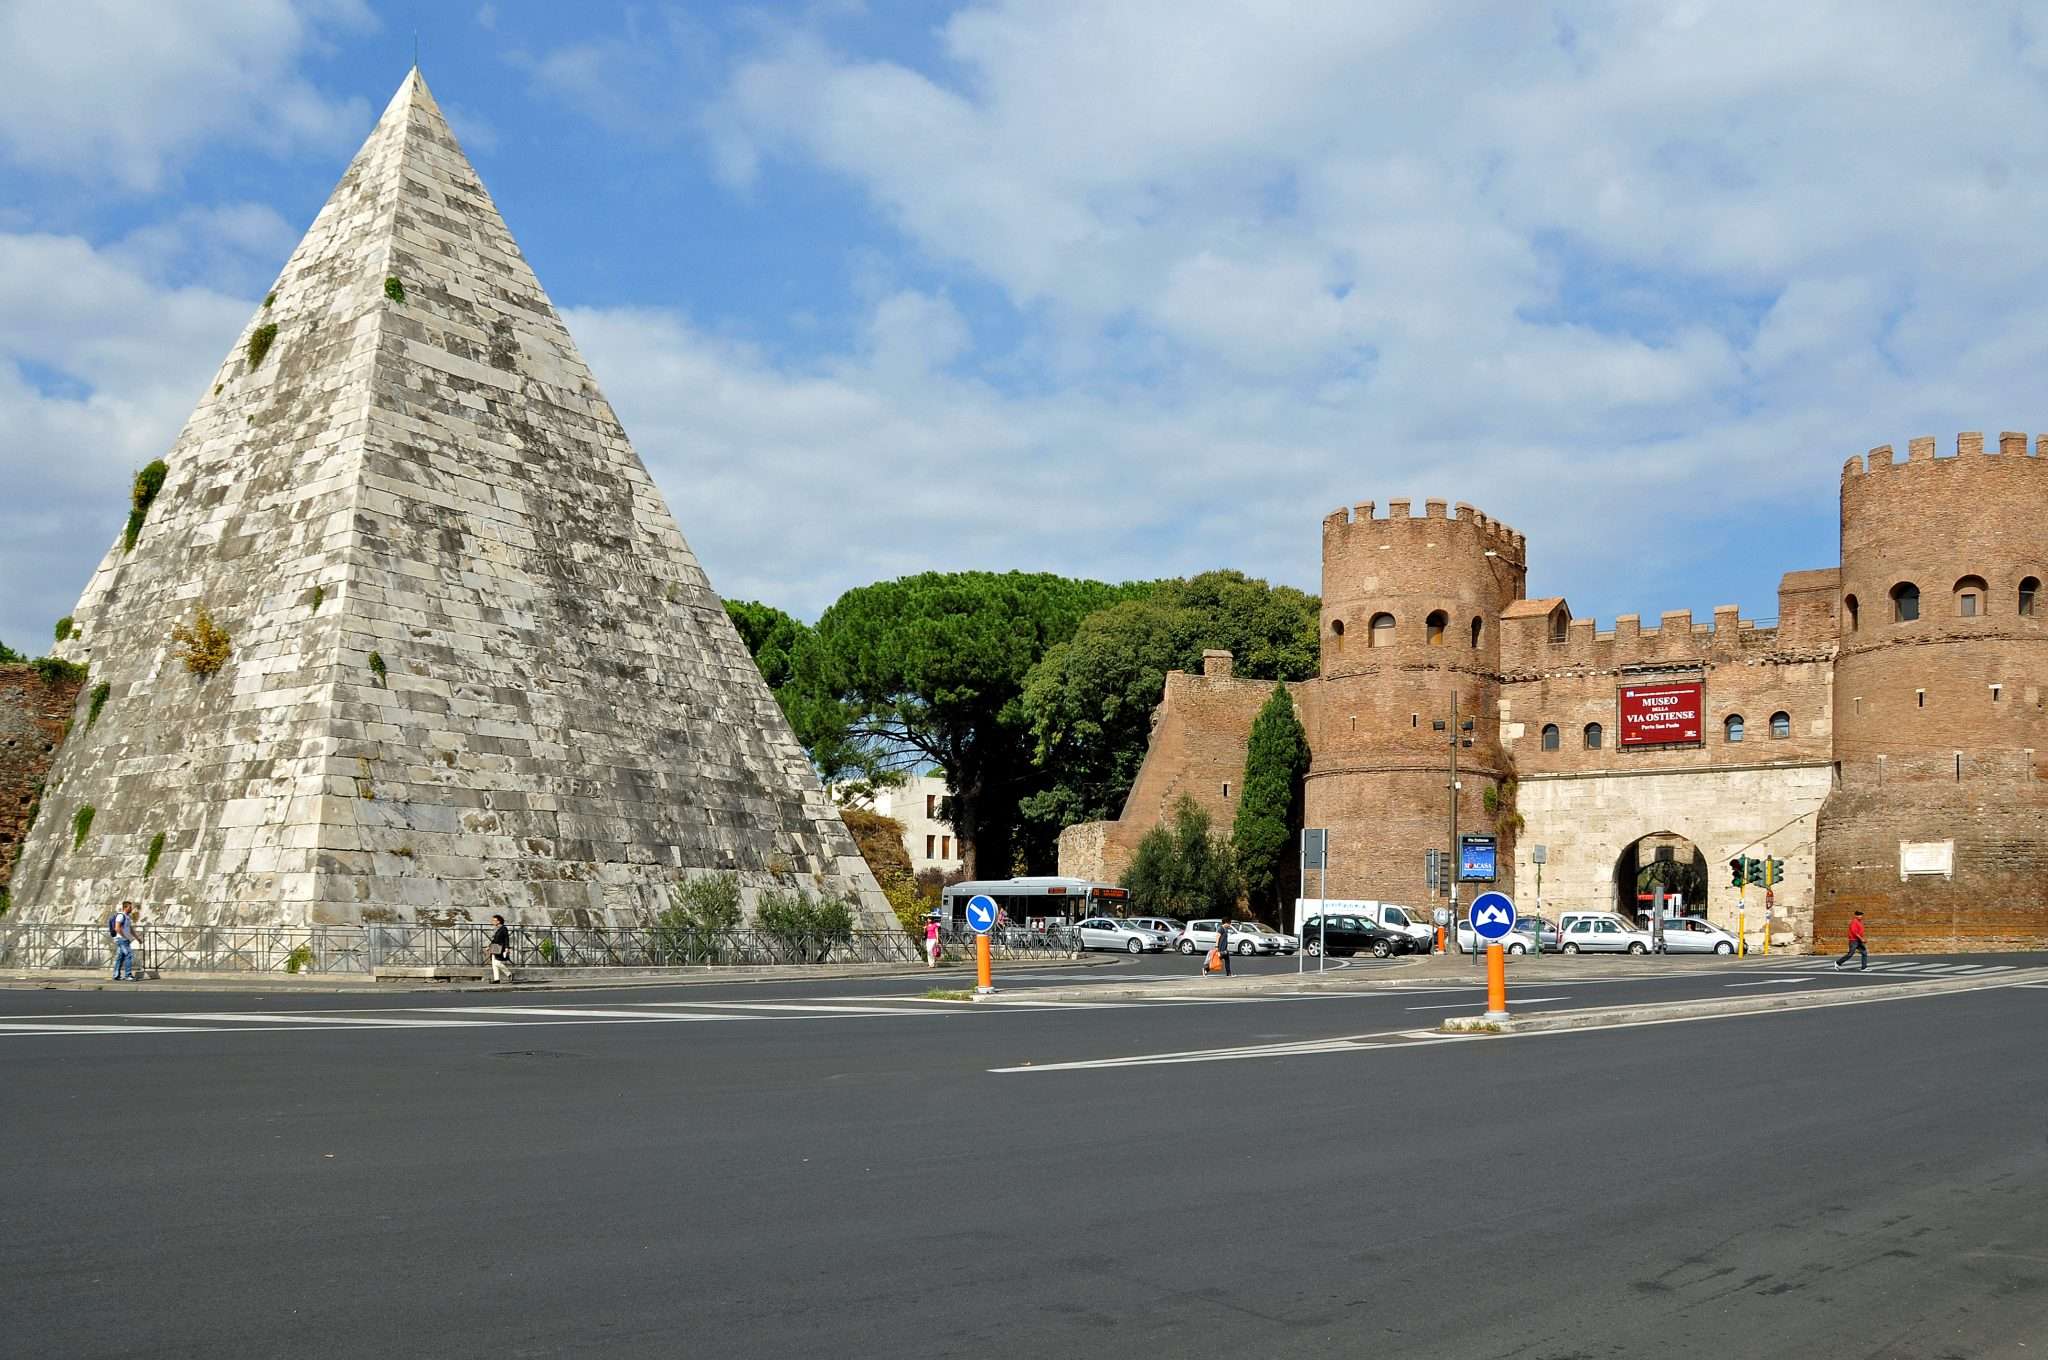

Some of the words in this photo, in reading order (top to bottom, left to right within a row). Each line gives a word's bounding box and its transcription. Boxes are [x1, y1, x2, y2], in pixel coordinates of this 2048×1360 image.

[1642, 697, 1678, 706] MUSEO
[1626, 714, 1645, 723] VIA
[1646, 711, 1695, 721] OSTIENSE
